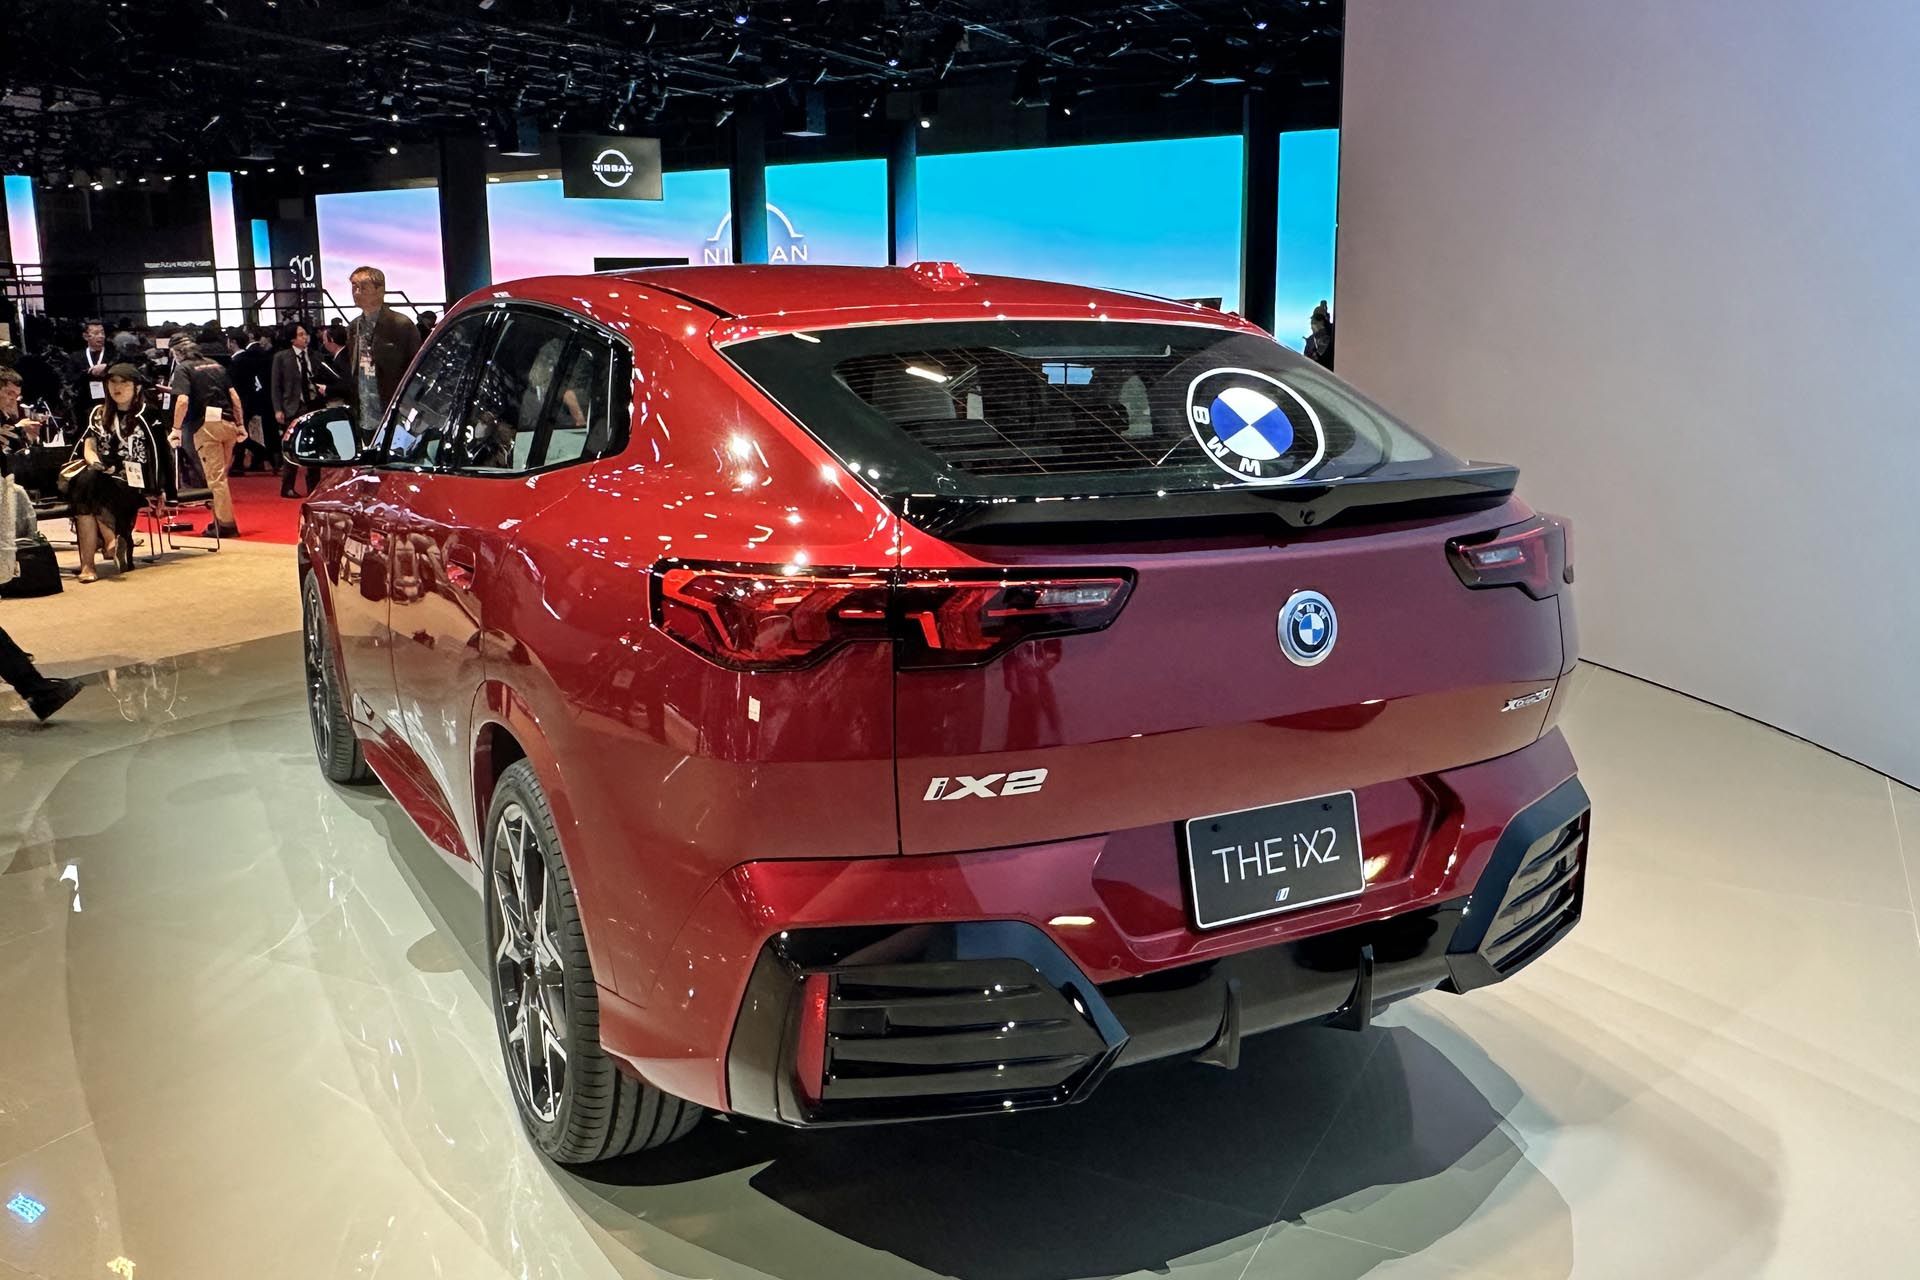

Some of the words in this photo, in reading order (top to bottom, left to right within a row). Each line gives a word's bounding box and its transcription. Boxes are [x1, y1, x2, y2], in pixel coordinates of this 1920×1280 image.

[704, 244, 808, 264] NIAN
[922, 767, 1049, 801] iX2
[1211, 837, 1287, 884] THE
[1293, 826, 1341, 869] iX2
